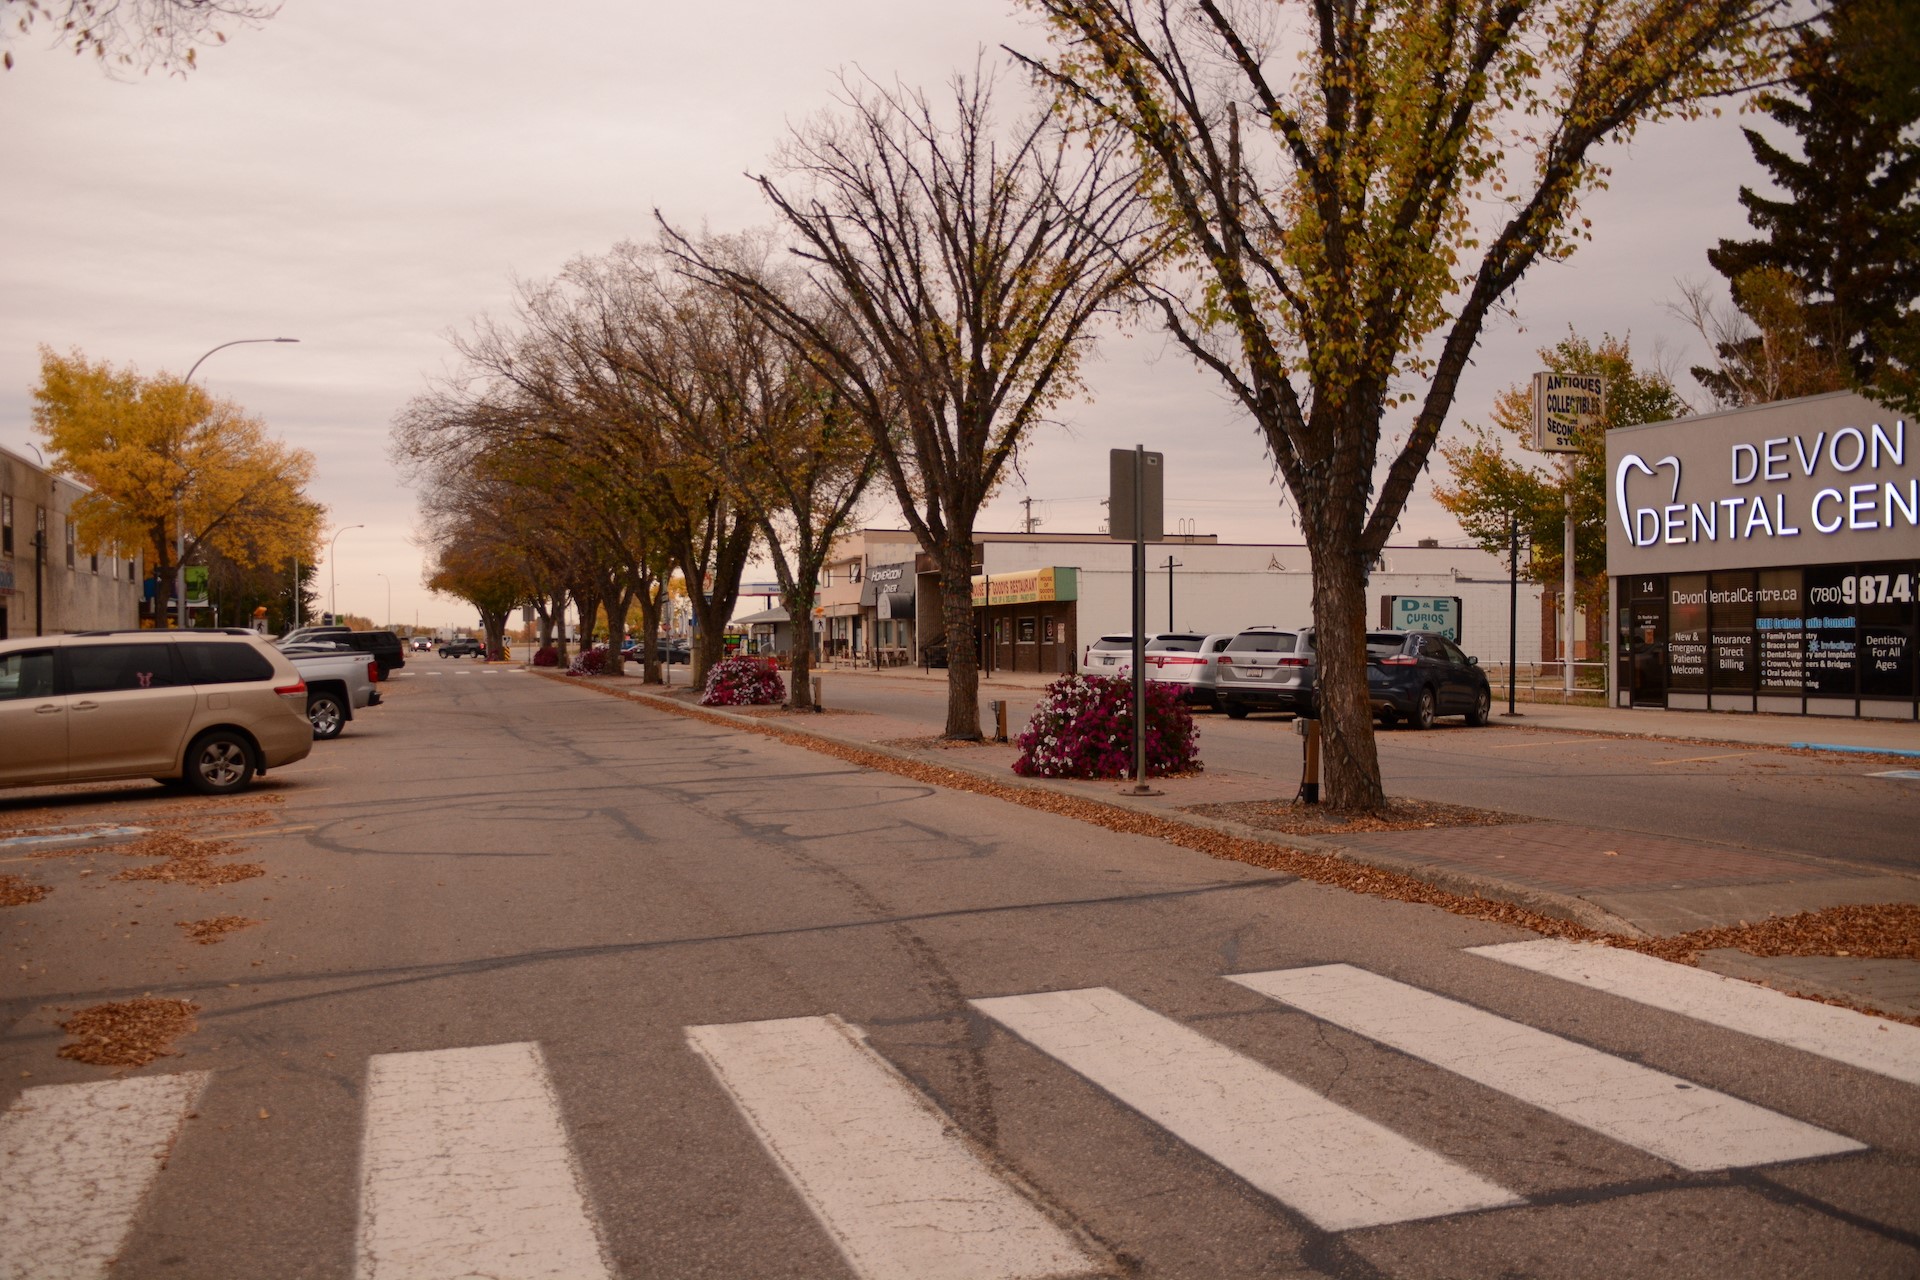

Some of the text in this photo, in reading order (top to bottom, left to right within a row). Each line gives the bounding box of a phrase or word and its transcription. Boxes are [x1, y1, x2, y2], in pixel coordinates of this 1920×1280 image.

[1547, 376, 1601, 395] ANTIQUES
[1547, 418, 1576, 436] SECON
[1732, 420, 1904, 485] DEVON
[1637, 479, 1919, 546] DENTAL CEN
[1010, 577, 1037, 594] RESTAURANT
[1643, 582, 1653, 592] 14
[1401, 599, 1420, 611] D
[1433, 600, 1449, 611] E
[1407, 613, 1444, 625] CURIOS
[1675, 631, 1699, 642] New &
[1712, 634, 1751, 645] Insurance
[1766, 632, 1786, 640] Family
[1866, 635, 1907, 646] Dentistry
[1668, 643, 1706, 654] Emergency
[1720, 646, 1744, 657] Direct
[1872, 647, 1900, 657] For All
[1673, 654, 1701, 664] Patients
[1827, 651, 1856, 659] Implants
[1671, 665, 1704, 675] Welcome
[1720, 659, 1744, 671] Billing
[1820, 660, 1826, 668] &
[1827, 660, 1851, 669] Bridges
[1875, 660, 1897, 671] Ages
